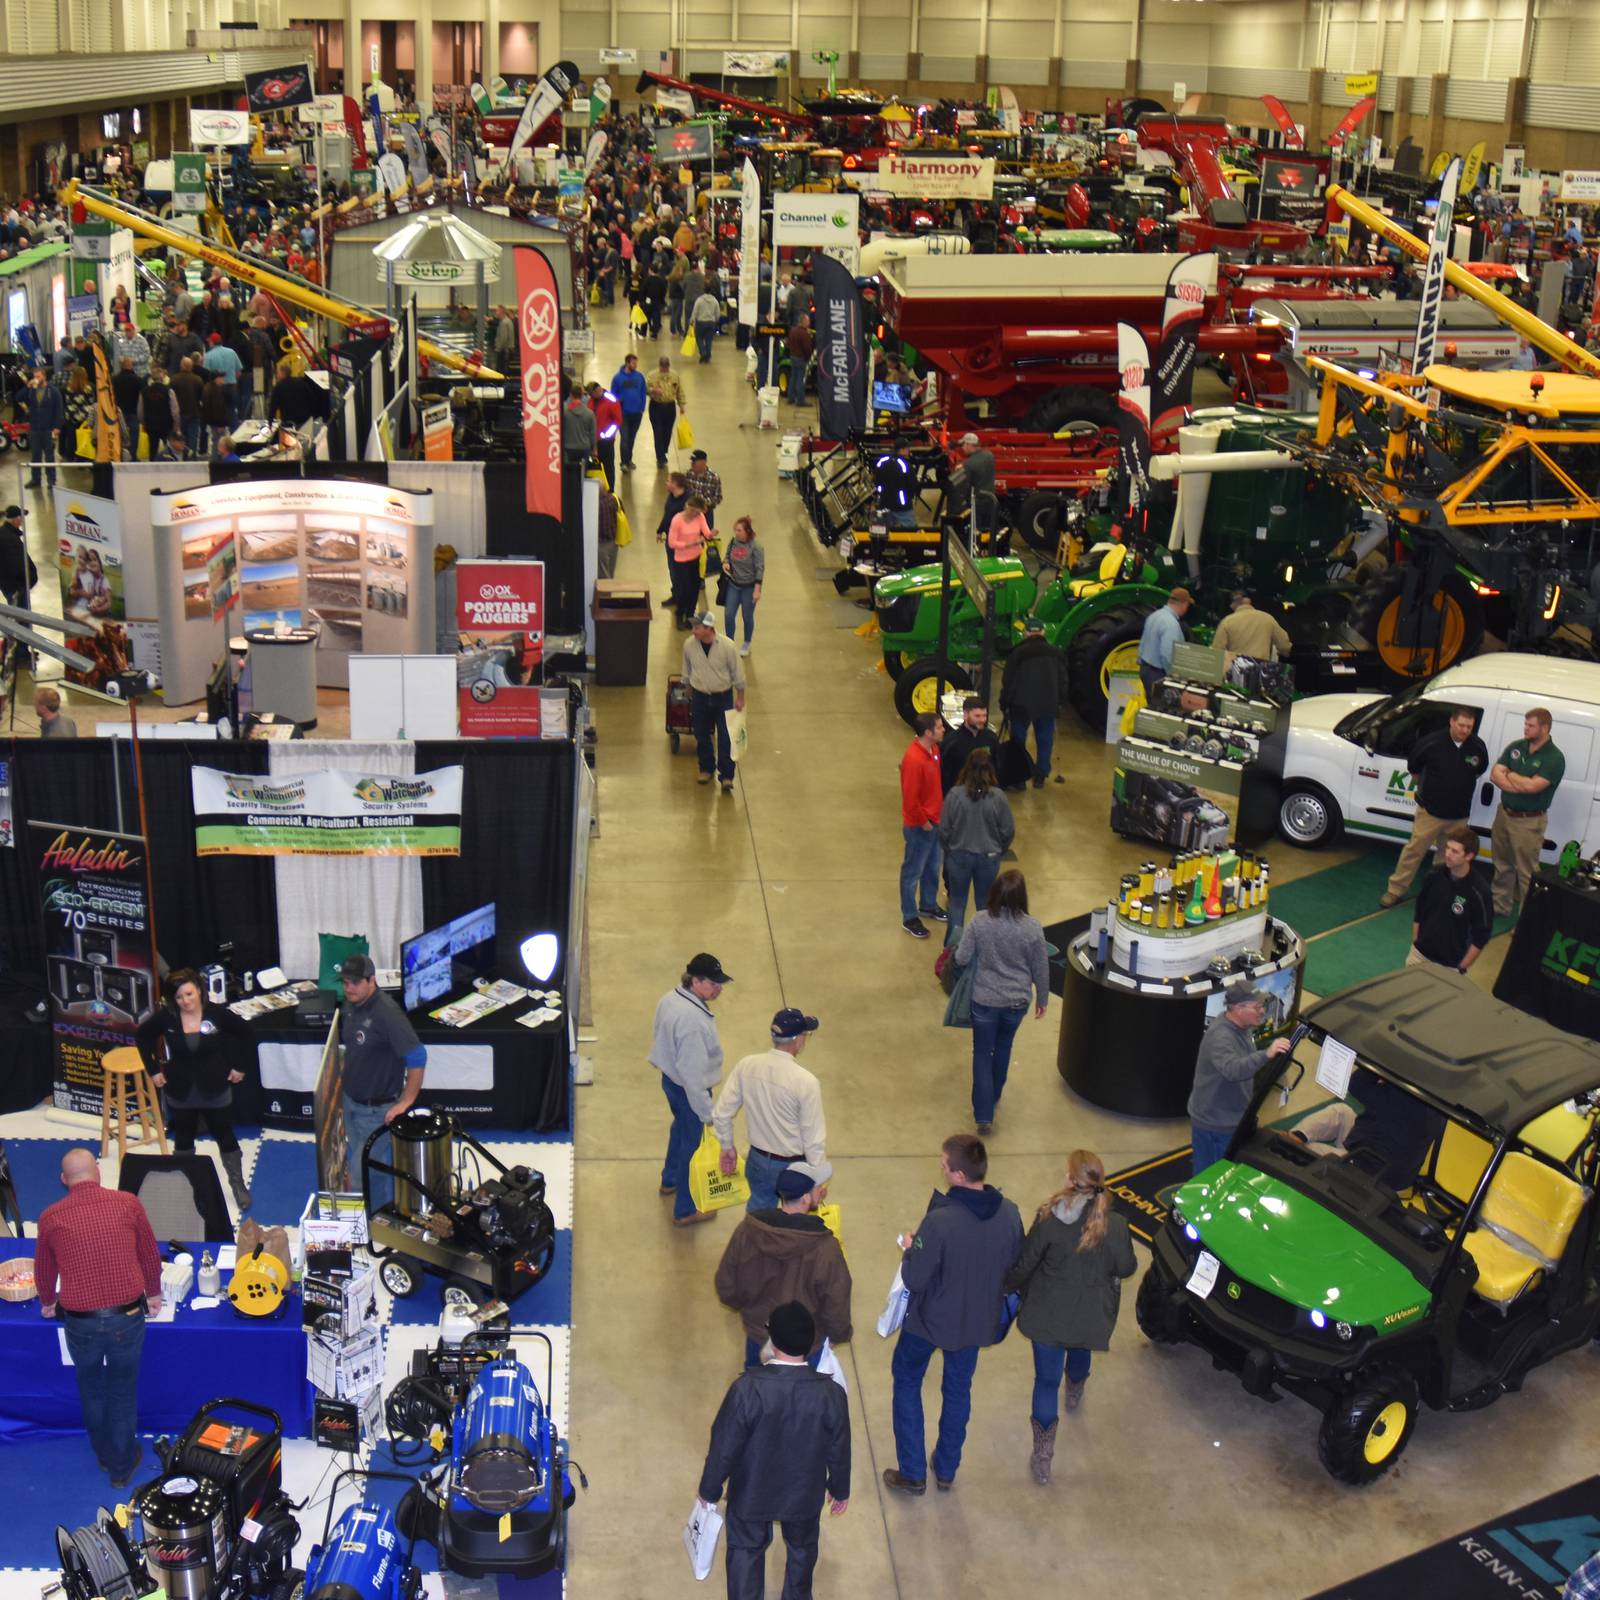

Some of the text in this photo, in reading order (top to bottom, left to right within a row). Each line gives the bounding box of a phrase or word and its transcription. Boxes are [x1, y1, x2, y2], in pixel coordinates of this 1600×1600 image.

[890, 160, 983, 178] Harmony
[779, 211, 827, 222] Channel
[411, 261, 459, 279] Sukup
[1177, 282, 1203, 303] SISCO
[830, 299, 850, 402] McFARLANE
[1157, 337, 1186, 380] Superior
[1163, 342, 1196, 396] Implement
[65, 519, 102, 539] HOMAN
[464, 602, 537, 614] PORTABLE
[472, 612, 529, 624] AUGERS
[1120, 747, 1201, 776] THE VALUE OF CHOICE
[252, 787, 305, 801] Watchman
[382, 784, 434, 801] Watchman
[362, 801, 428, 810] Security Systems
[362, 815, 414, 827] Residential
[40, 831, 142, 872] Aaladin
[77, 881, 142, 897] INTRODUCING
[60, 908, 145, 930] 70 SERIES
[1546, 930, 1600, 978] KF
[60, 1042, 93, 1058] Saving
[1108, 1185, 1160, 1216] JOHN
